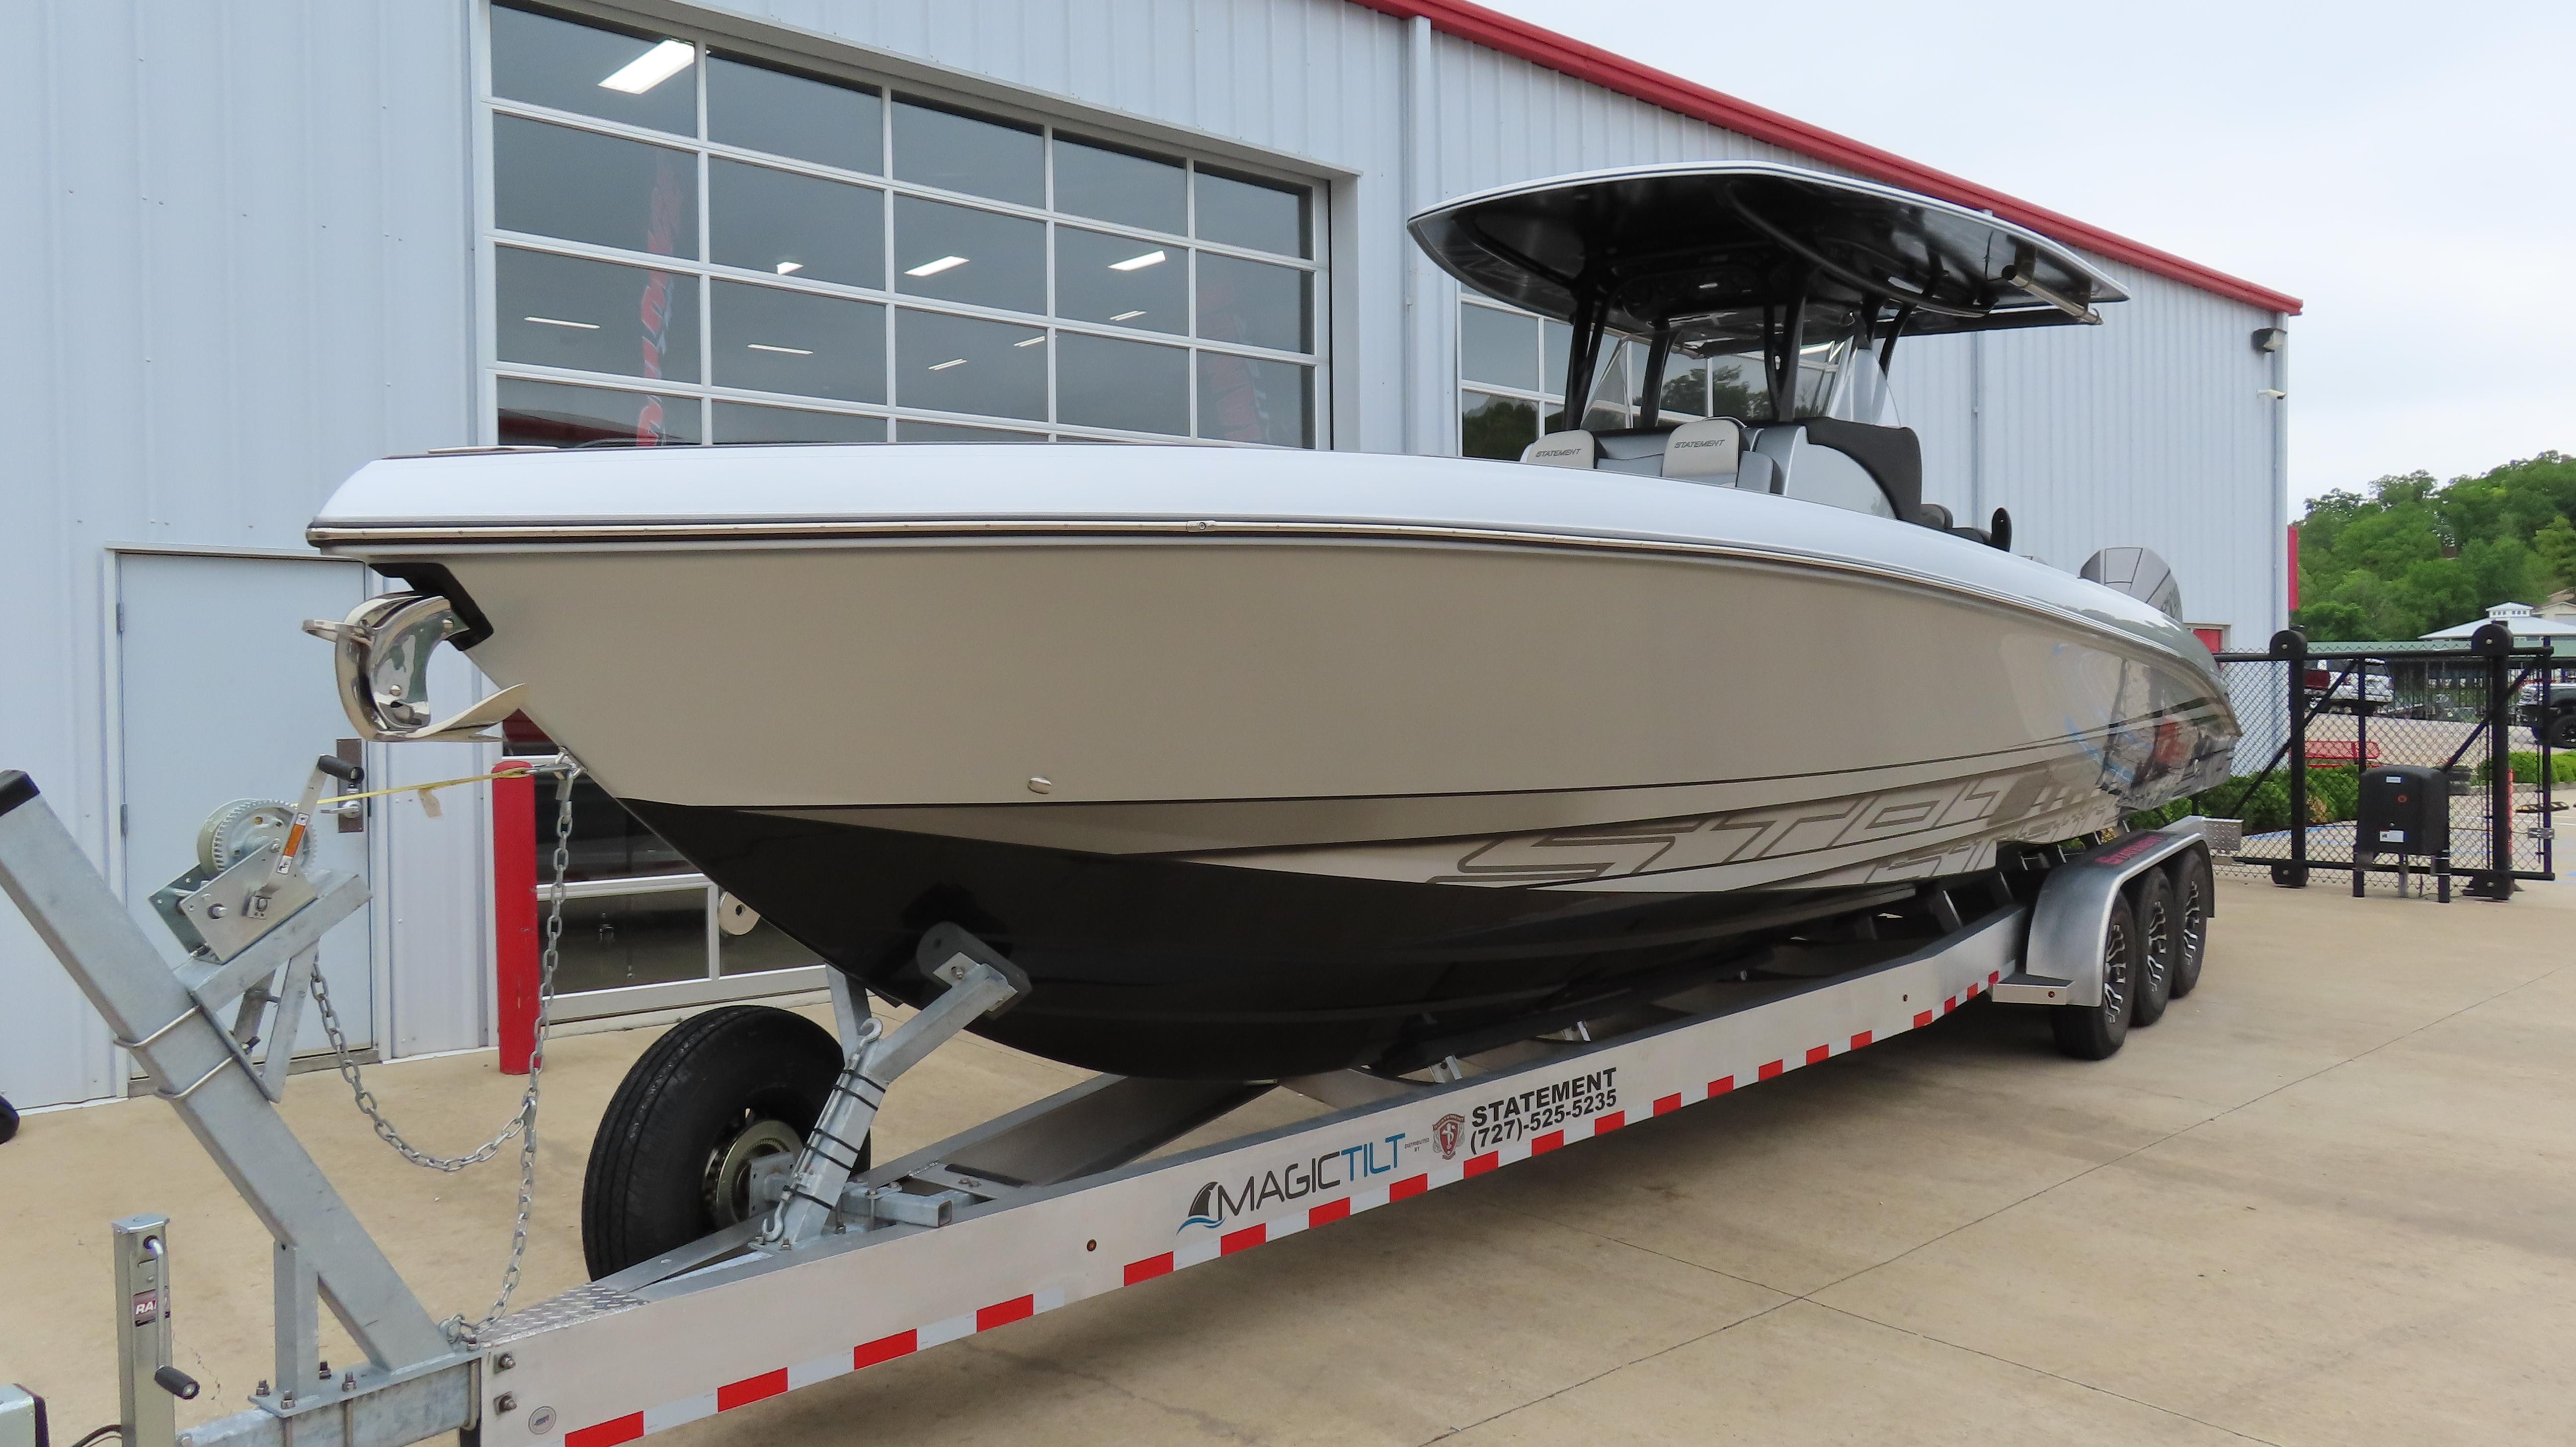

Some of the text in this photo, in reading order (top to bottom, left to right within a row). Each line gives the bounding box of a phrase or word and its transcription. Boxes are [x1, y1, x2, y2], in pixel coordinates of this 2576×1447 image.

[1535, 448, 1582, 458] STATEMENT
[1674, 439, 1726, 448] STATEMENT
[1472, 1067, 1617, 1127] STATEMENT
[1470, 1089, 1617, 1155] (727)-525-5235
